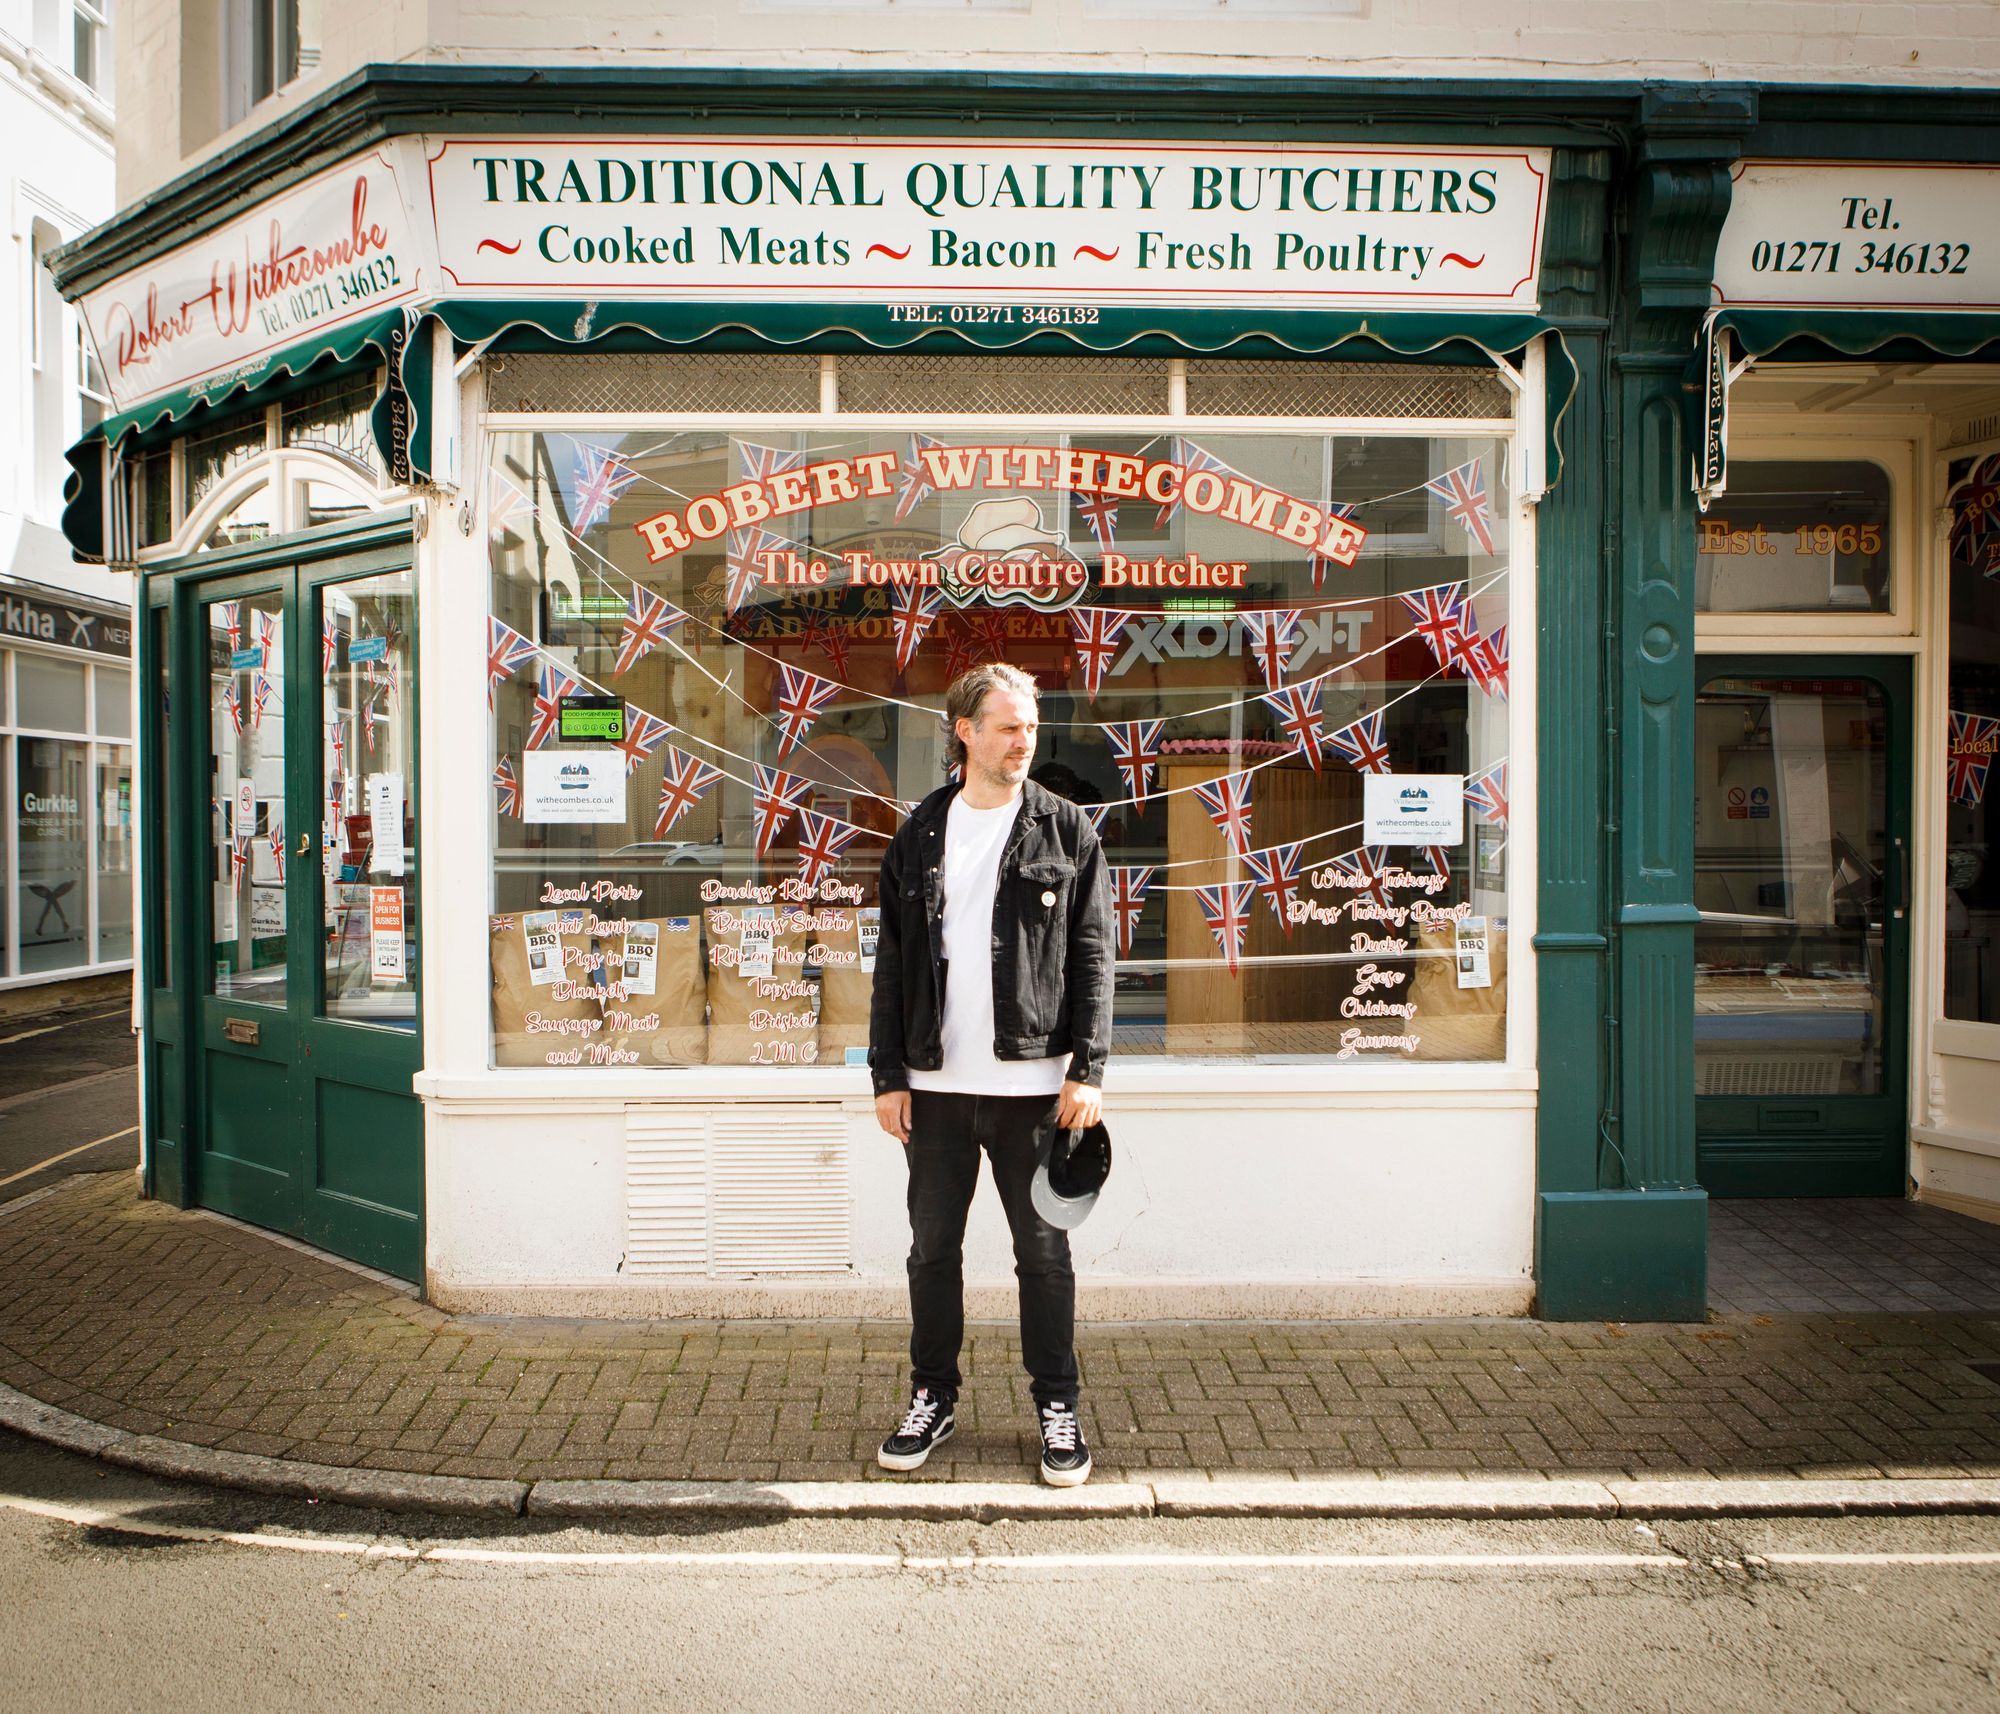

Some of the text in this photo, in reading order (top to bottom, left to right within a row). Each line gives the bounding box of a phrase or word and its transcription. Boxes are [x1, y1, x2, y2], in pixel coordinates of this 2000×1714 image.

[472, 157, 1498, 217] TRADITIONAL QUALITY BUTCHERS
[1841, 197, 1900, 230] Tel.
[538, 224, 1435, 281] Cooked Meats Bacon Fresh Poultry
[1750, 240, 1971, 275] 01271 346132
[105, 175, 388, 377] Robert Withecombe
[257, 254, 401, 337] Tel. 01271 346132
[888, 304, 1100, 324] TEL: 01271 346132
[391, 401, 407, 479] 346132
[1708, 415, 1720, 479] 01271
[635, 445, 1369, 569] ROBERT WITHECOMBE
[1699, 519, 1882, 556] Est. 1965
[756, 549, 829, 587] The
[842, 550, 941, 588] Town
[957, 551, 1088, 589] Centre
[1100, 552, 1248, 590] Butcher
[103, 625, 131, 645] NEP
[610, 723, 617, 731] 5
[1952, 735, 1999, 755] Local
[24, 792, 78, 813] Gurkha
[536, 796, 615, 804] withecombes.co.uk
[1376, 819, 1452, 827] withecombes.co.uk
[540, 881, 643, 904] Local Pork
[701, 879, 777, 903] Boneless
[779, 878, 819, 900] Rib
[821, 879, 864, 905] Beef
[1311, 867, 1449, 895] Whole Turkeys
[375, 906, 400, 914] OPEN FOR
[375, 917, 400, 925] BUSINESS
[1286, 899, 1471, 928] B/less Turkey Breast
[546, 914, 632, 936] and Lamb
[713, 910, 853, 935] Boneless Sirloin
[862, 927, 879, 937] BB
[530, 934, 557, 947] BBQ
[745, 930, 770, 939] BBQ
[1350, 932, 1408, 955] Ducks
[1460, 939, 1485, 950] BBQ
[561, 947, 625, 972] Pigs in
[627, 945, 654, 957] BBQ
[709, 944, 857, 967] Rib on the Bone
[552, 980, 631, 1002] Blankets
[748, 976, 819, 1001] Topside
[1353, 964, 1406, 995] Geese
[1341, 996, 1417, 1020] Chickens
[525, 1010, 660, 1038] Sausage Meat
[749, 1009, 818, 1032] Brisket
[546, 1043, 639, 1065] and More
[1337, 1028, 1420, 1060] Gammons
